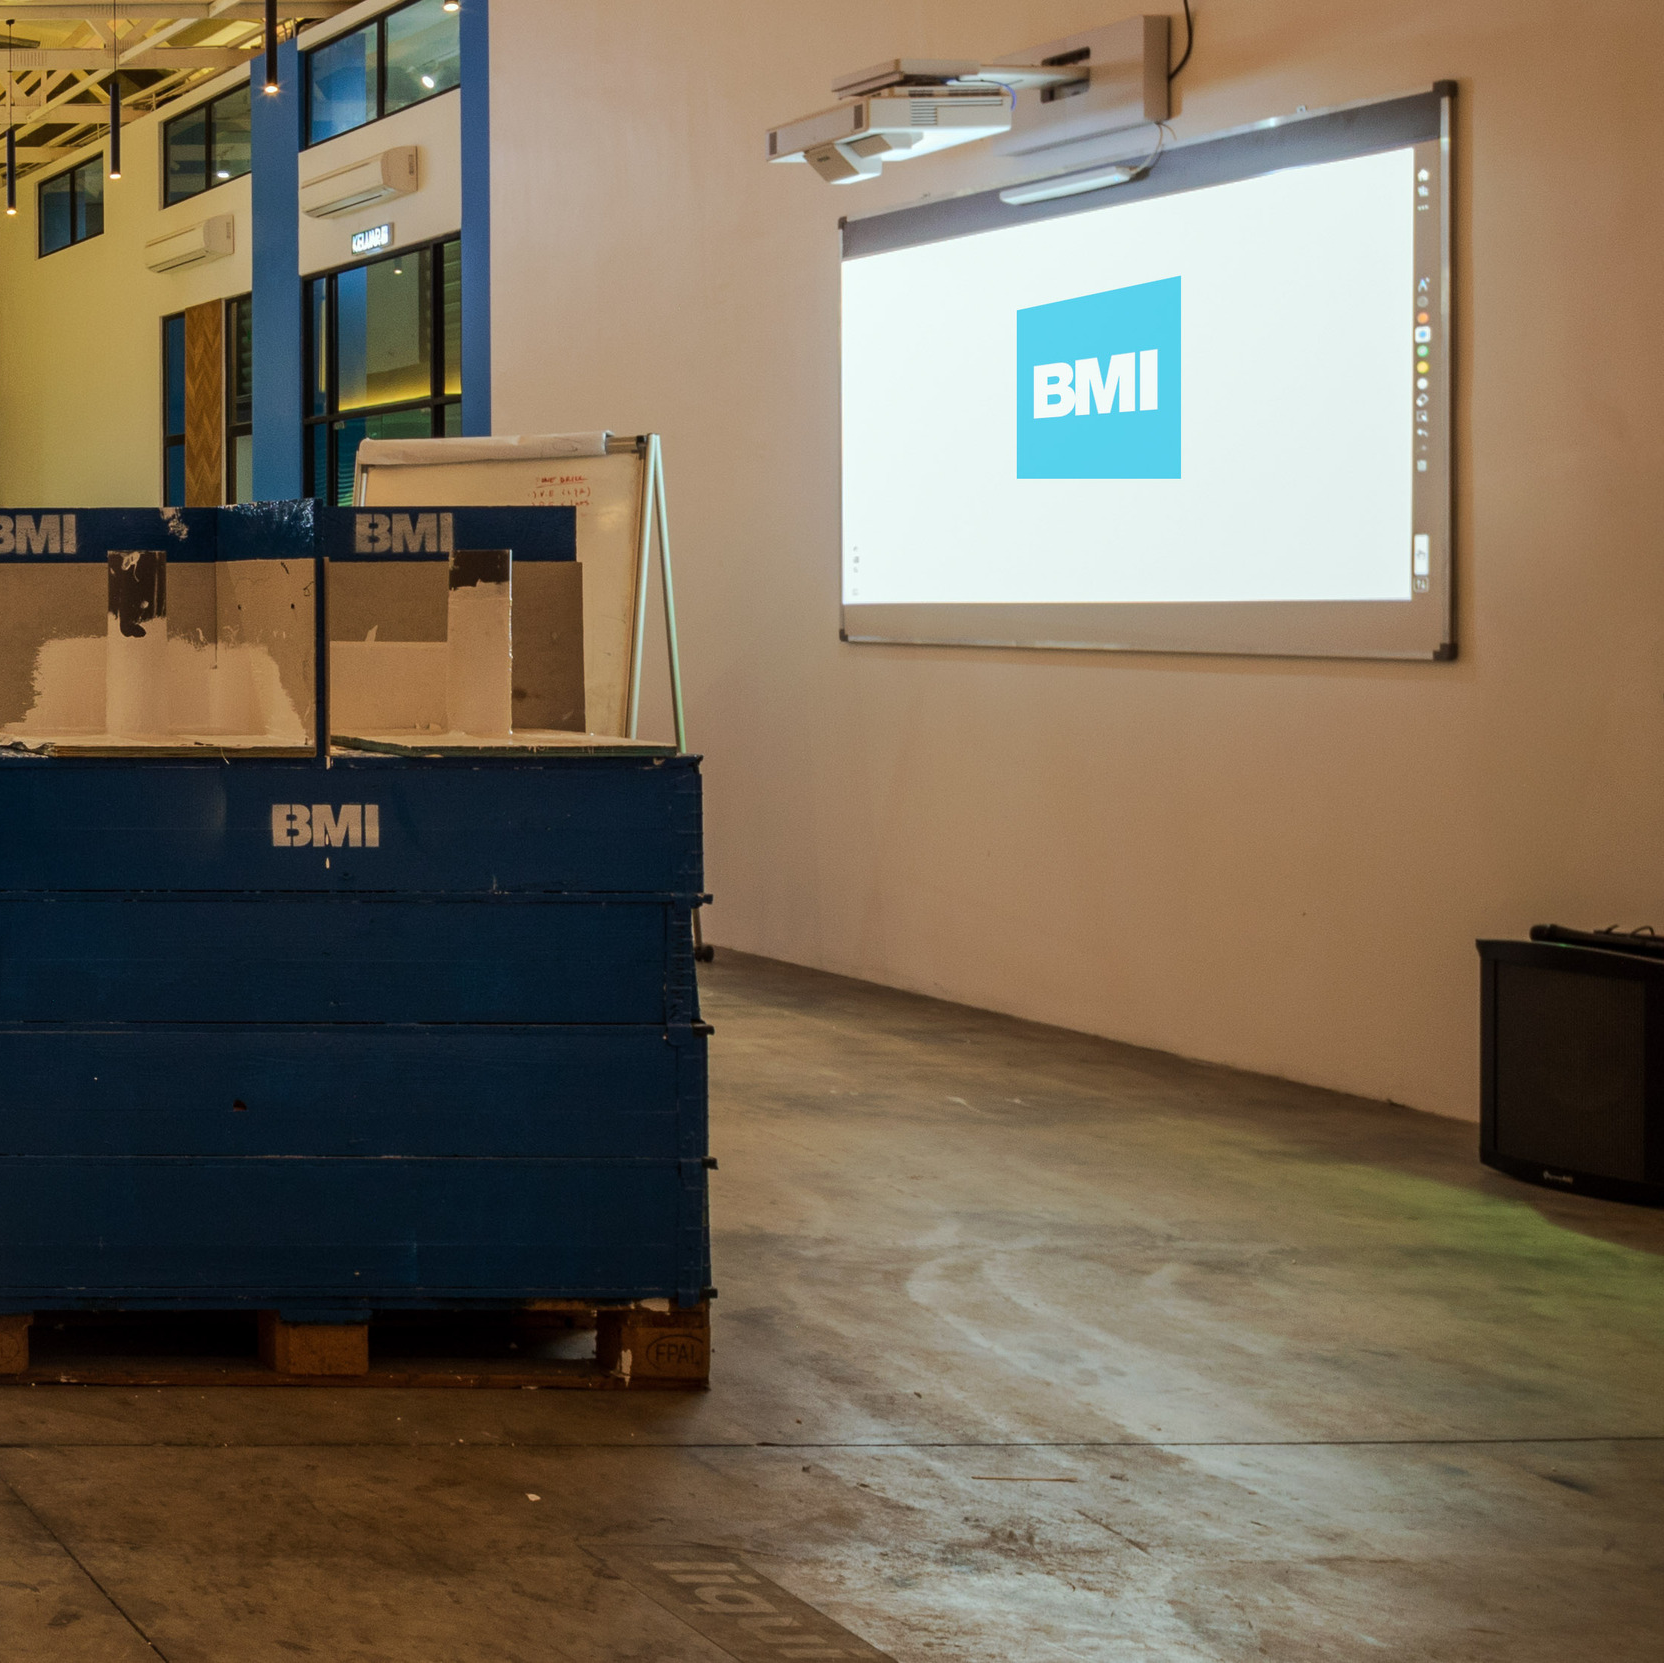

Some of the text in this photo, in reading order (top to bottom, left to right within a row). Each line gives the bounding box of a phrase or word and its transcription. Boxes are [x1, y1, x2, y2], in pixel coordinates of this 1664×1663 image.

[1033, 348, 1159, 420] BMI
[354, 512, 453, 554] BMI
[270, 803, 381, 848] BMI
